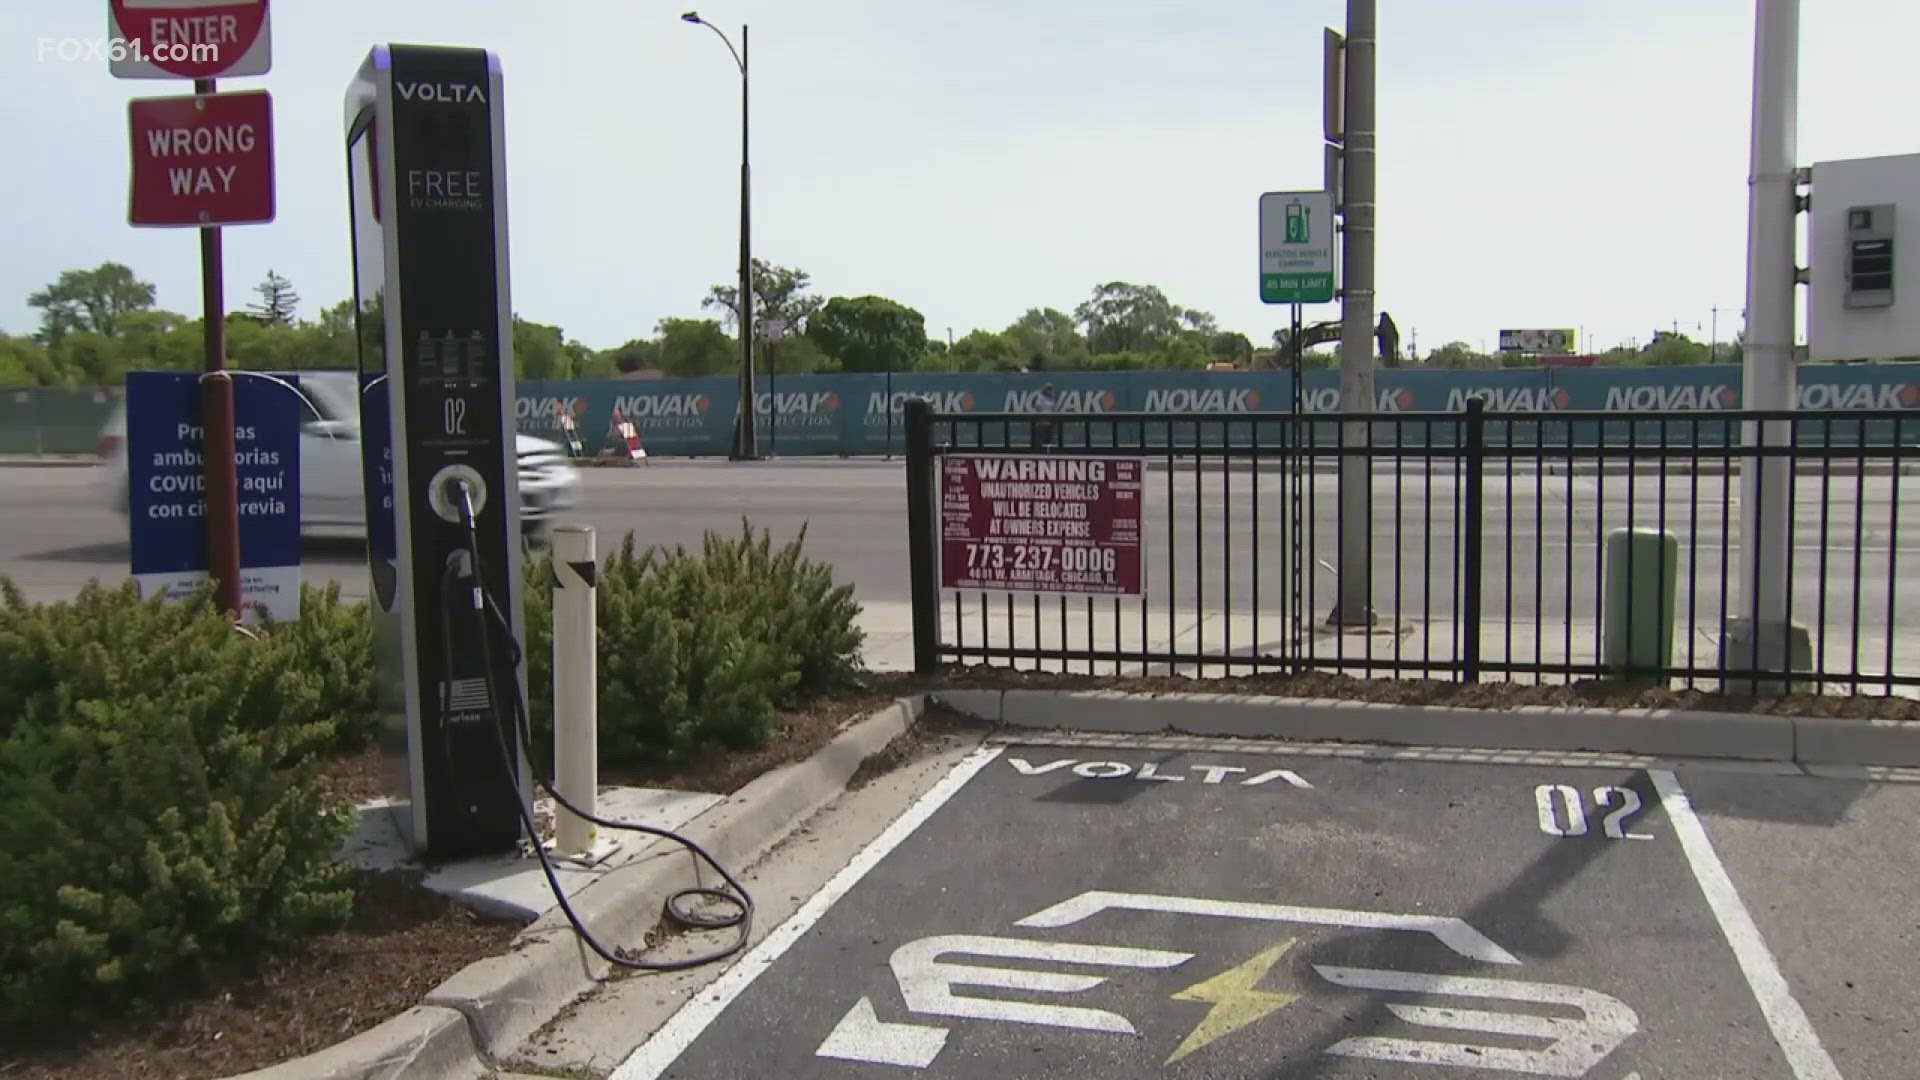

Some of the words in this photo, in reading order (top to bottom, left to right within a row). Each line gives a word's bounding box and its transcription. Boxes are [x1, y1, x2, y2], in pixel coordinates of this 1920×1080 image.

[151, 15, 238, 45] ENTER
[396, 81, 487, 104] VOLTA
[147, 124, 255, 157] WRONG
[169, 165, 237, 196] WAY
[408, 170, 481, 196] FREE
[1301, 279, 1327, 288] LIMIT
[515, 396, 578, 418] OVAK
[612, 394, 703, 416] NOVAK
[736, 392, 831, 415] OVAK
[867, 391, 964, 414] NOAK
[1145, 388, 1251, 412] NOVAK
[1300, 388, 1404, 411] NOK
[1445, 386, 1561, 411] NOVAK
[1605, 385, 1726, 410] NOVAK
[445, 398, 466, 434] 02
[177, 423, 256, 441] Pras
[153, 448, 280, 466] ambuorias
[974, 458, 1106, 482] WARNING
[243, 471, 285, 493] aquí
[980, 482, 1051, 499] UNAUTHORIZED
[1053, 483, 1099, 501] VEHICLES
[149, 504, 183, 518] con
[992, 501, 1017, 517] WILL
[1019, 502, 1031, 517] BE
[1033, 502, 1087, 518] RELOCATED
[989, 519, 1001, 534] AT
[1003, 519, 1045, 536] OWNERS
[1046, 520, 1091, 537] EXPENSE
[966, 543, 1116, 572] 773-237-0006
[1007, 757, 1317, 790] VOLTA
[1534, 783, 1655, 841] 02
